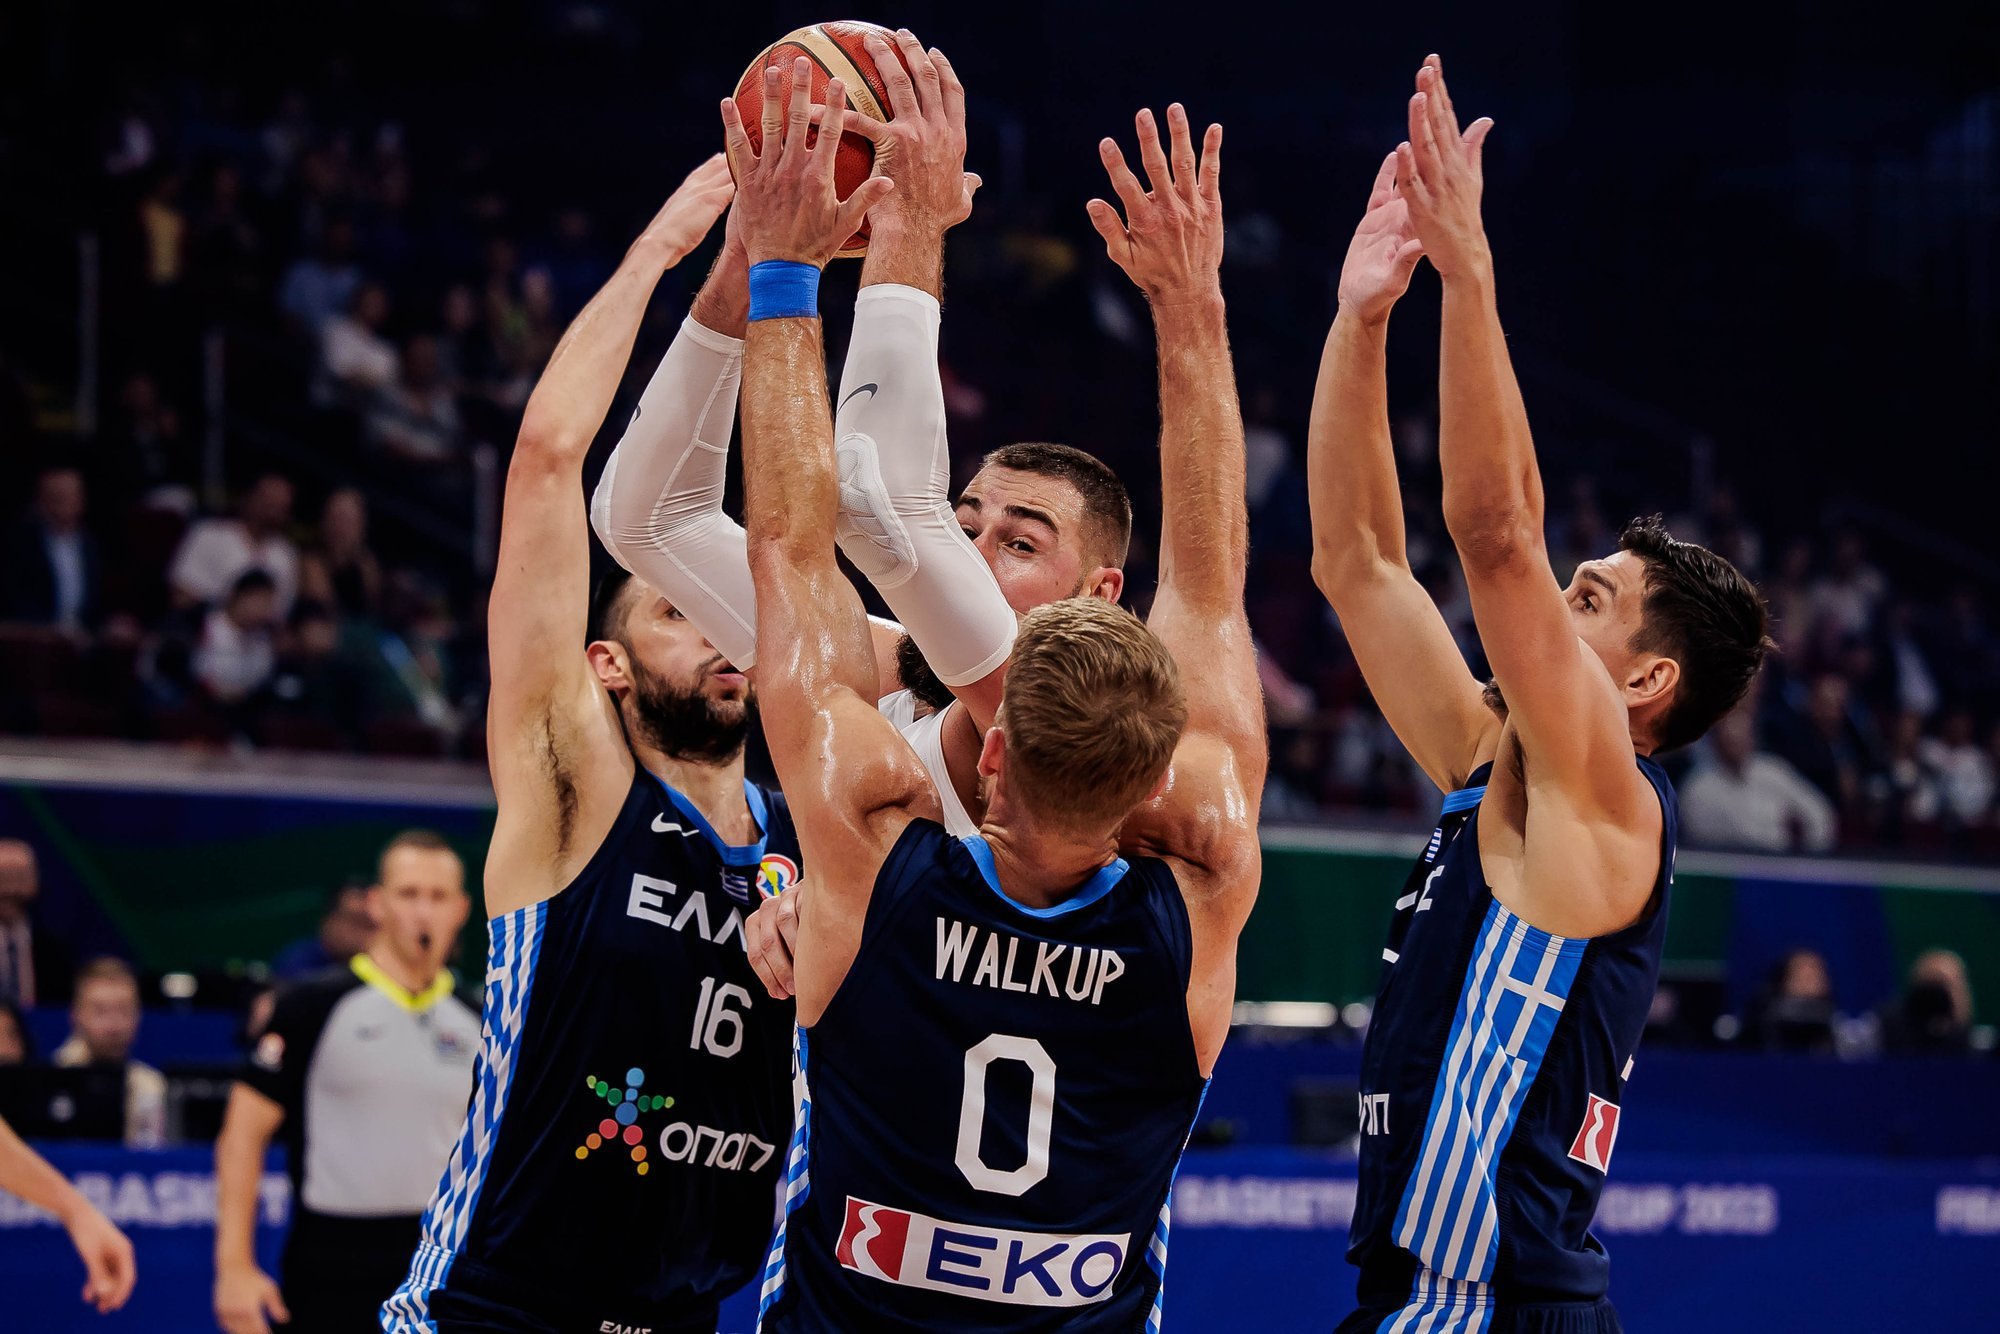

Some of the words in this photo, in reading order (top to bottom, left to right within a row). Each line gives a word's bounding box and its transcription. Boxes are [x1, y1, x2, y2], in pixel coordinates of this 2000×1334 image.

[626, 873, 748, 954] ΕΛΛ
[936, 917, 1125, 1005] WALKUP
[690, 977, 752, 1059] 16
[955, 1033, 1056, 1196] 0
[926, 1227, 1123, 1298] EKO
